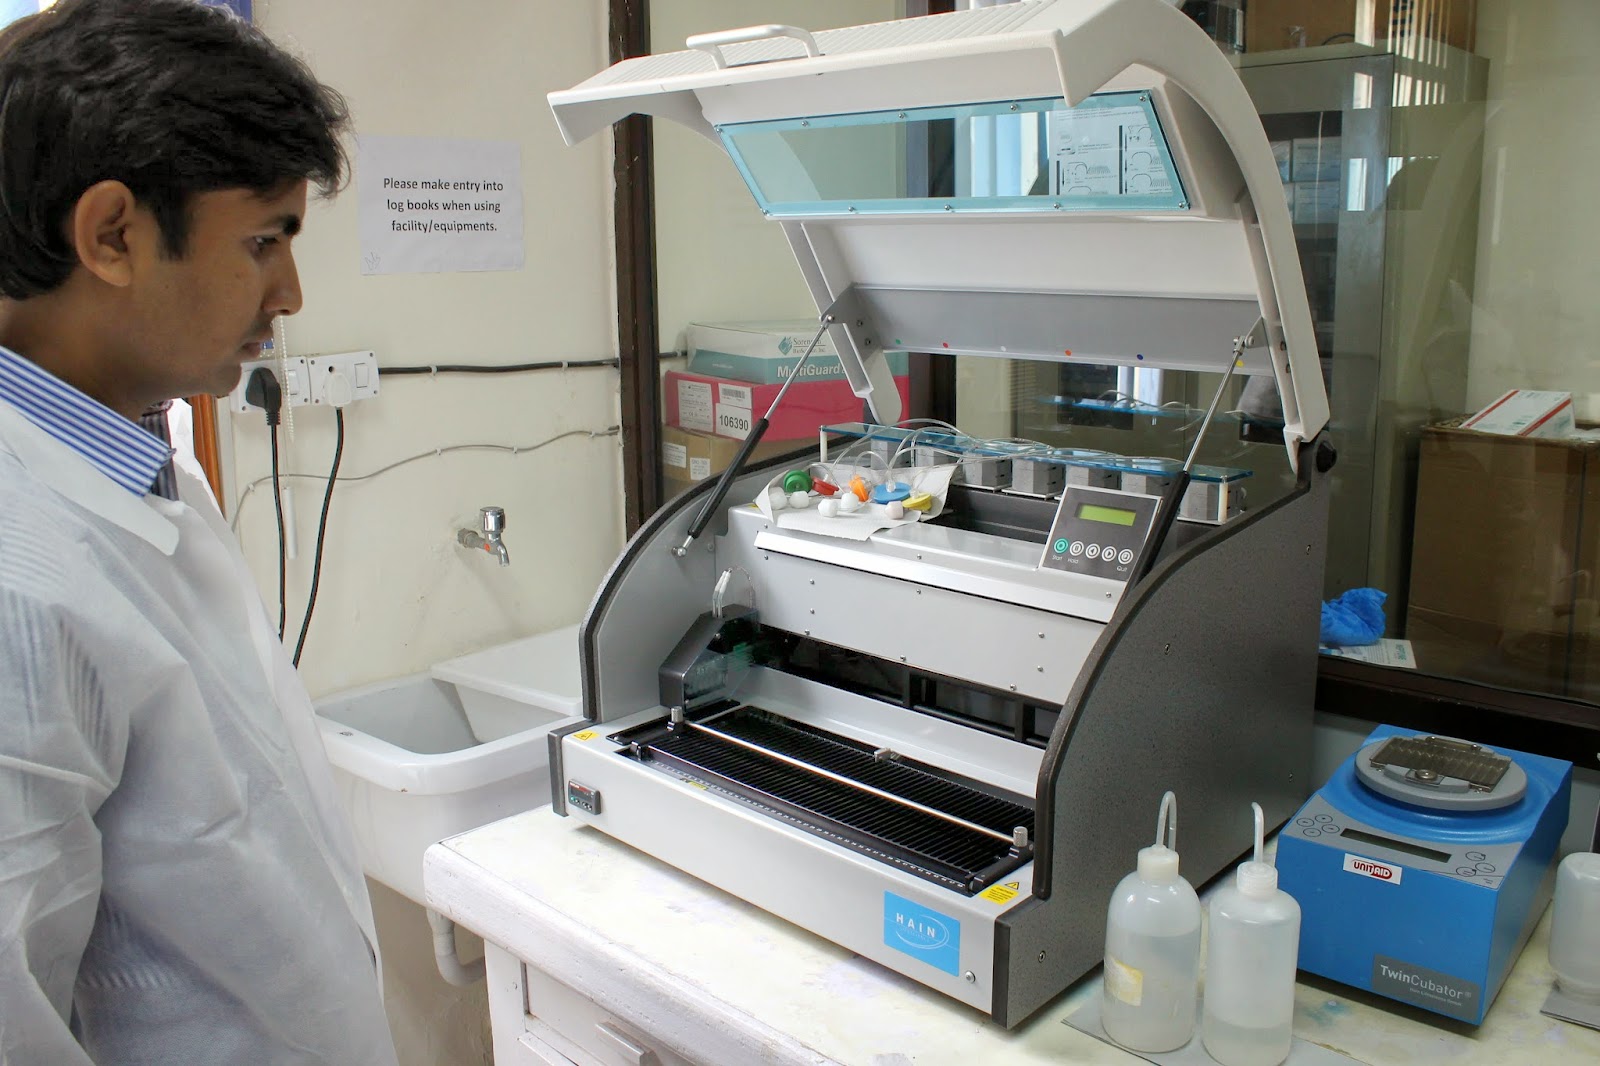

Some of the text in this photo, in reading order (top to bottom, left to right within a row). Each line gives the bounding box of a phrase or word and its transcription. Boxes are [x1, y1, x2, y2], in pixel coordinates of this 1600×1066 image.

[383, 177, 504, 193] Please make entry into
[387, 199, 501, 213] log books when using
[391, 219, 497, 233] facility/equipments.
[719, 414, 749, 431] 106390
[1353, 861, 1391, 878] UNITAID
[896, 912, 935, 938] HAIN
